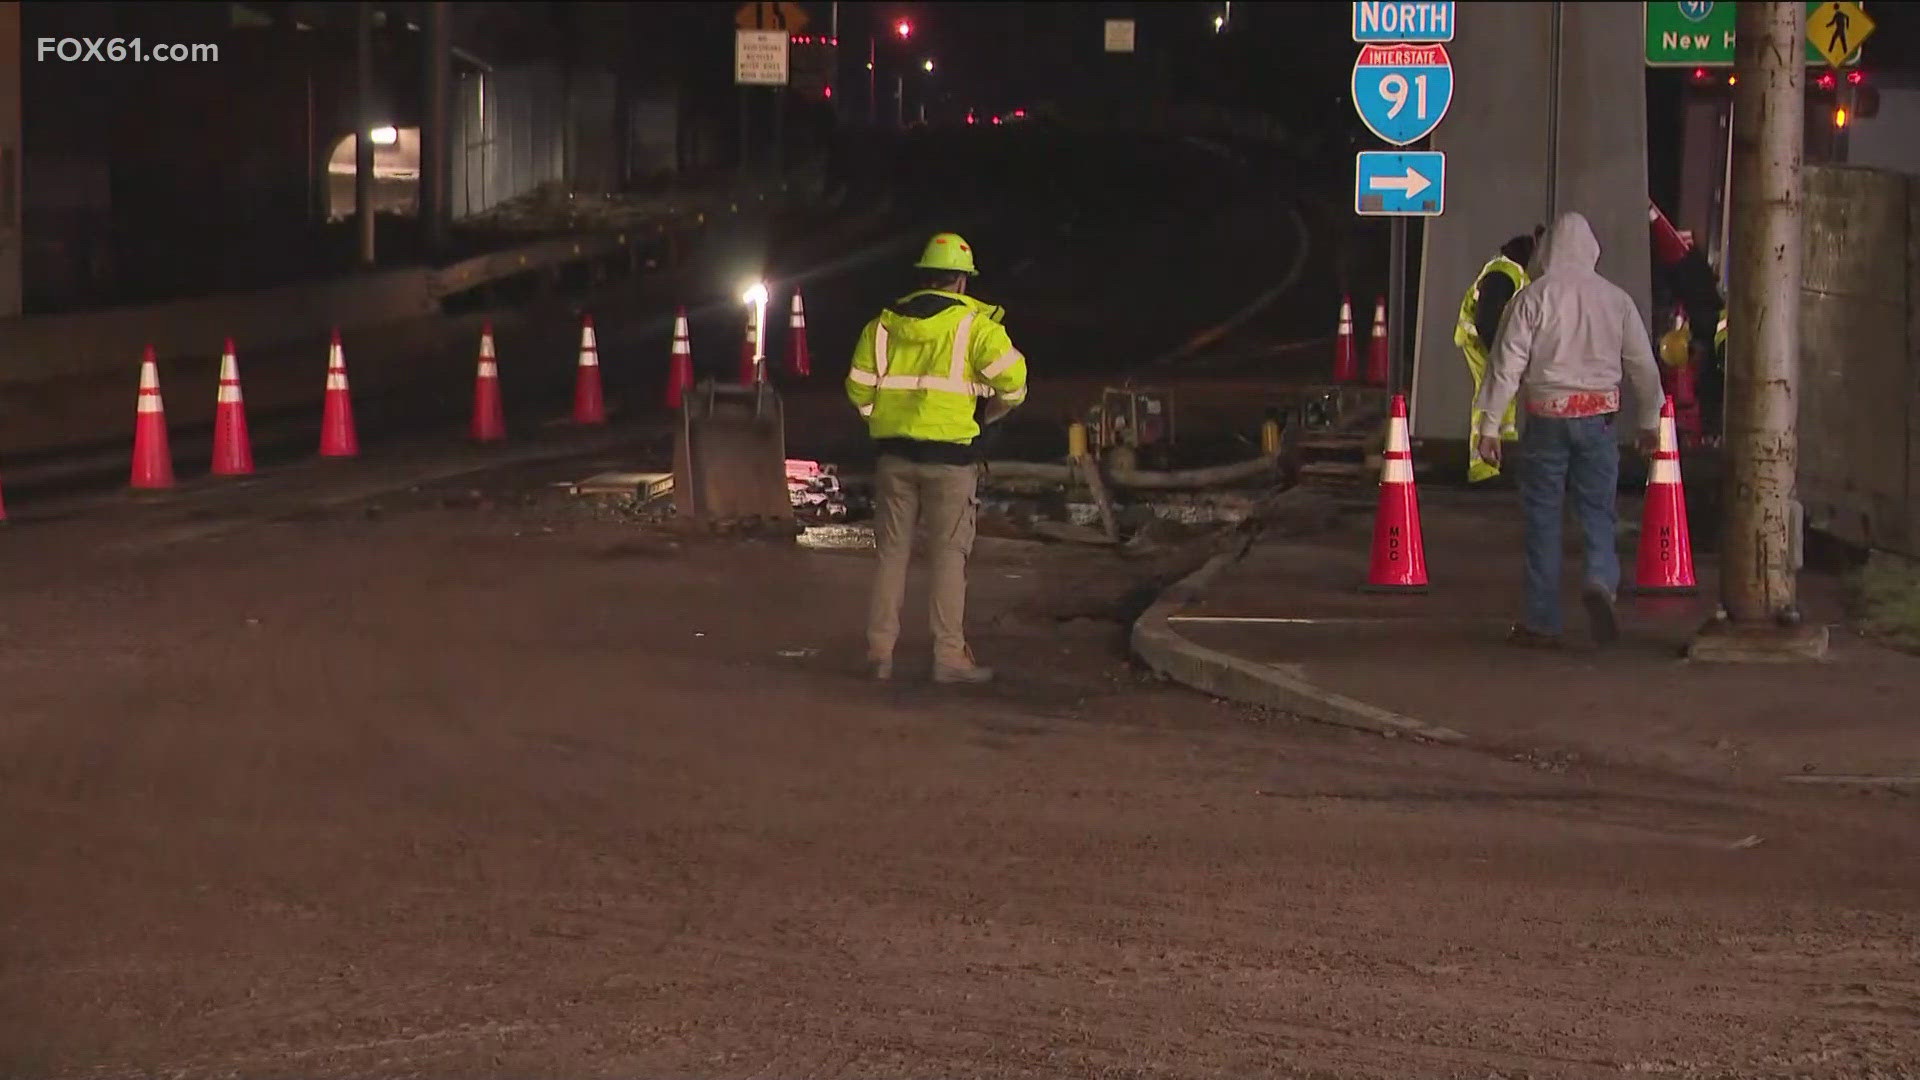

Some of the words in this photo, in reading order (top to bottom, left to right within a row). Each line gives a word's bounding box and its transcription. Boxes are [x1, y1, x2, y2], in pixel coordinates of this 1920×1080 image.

[1360, 2, 1447, 33] NORTH
[1662, 30, 1710, 50] New
[1369, 50, 1436, 65] INTERSTATE
[1379, 73, 1427, 120] 91
[1389, 526, 1399, 561] MDC
[1660, 526, 1670, 561] MDC
